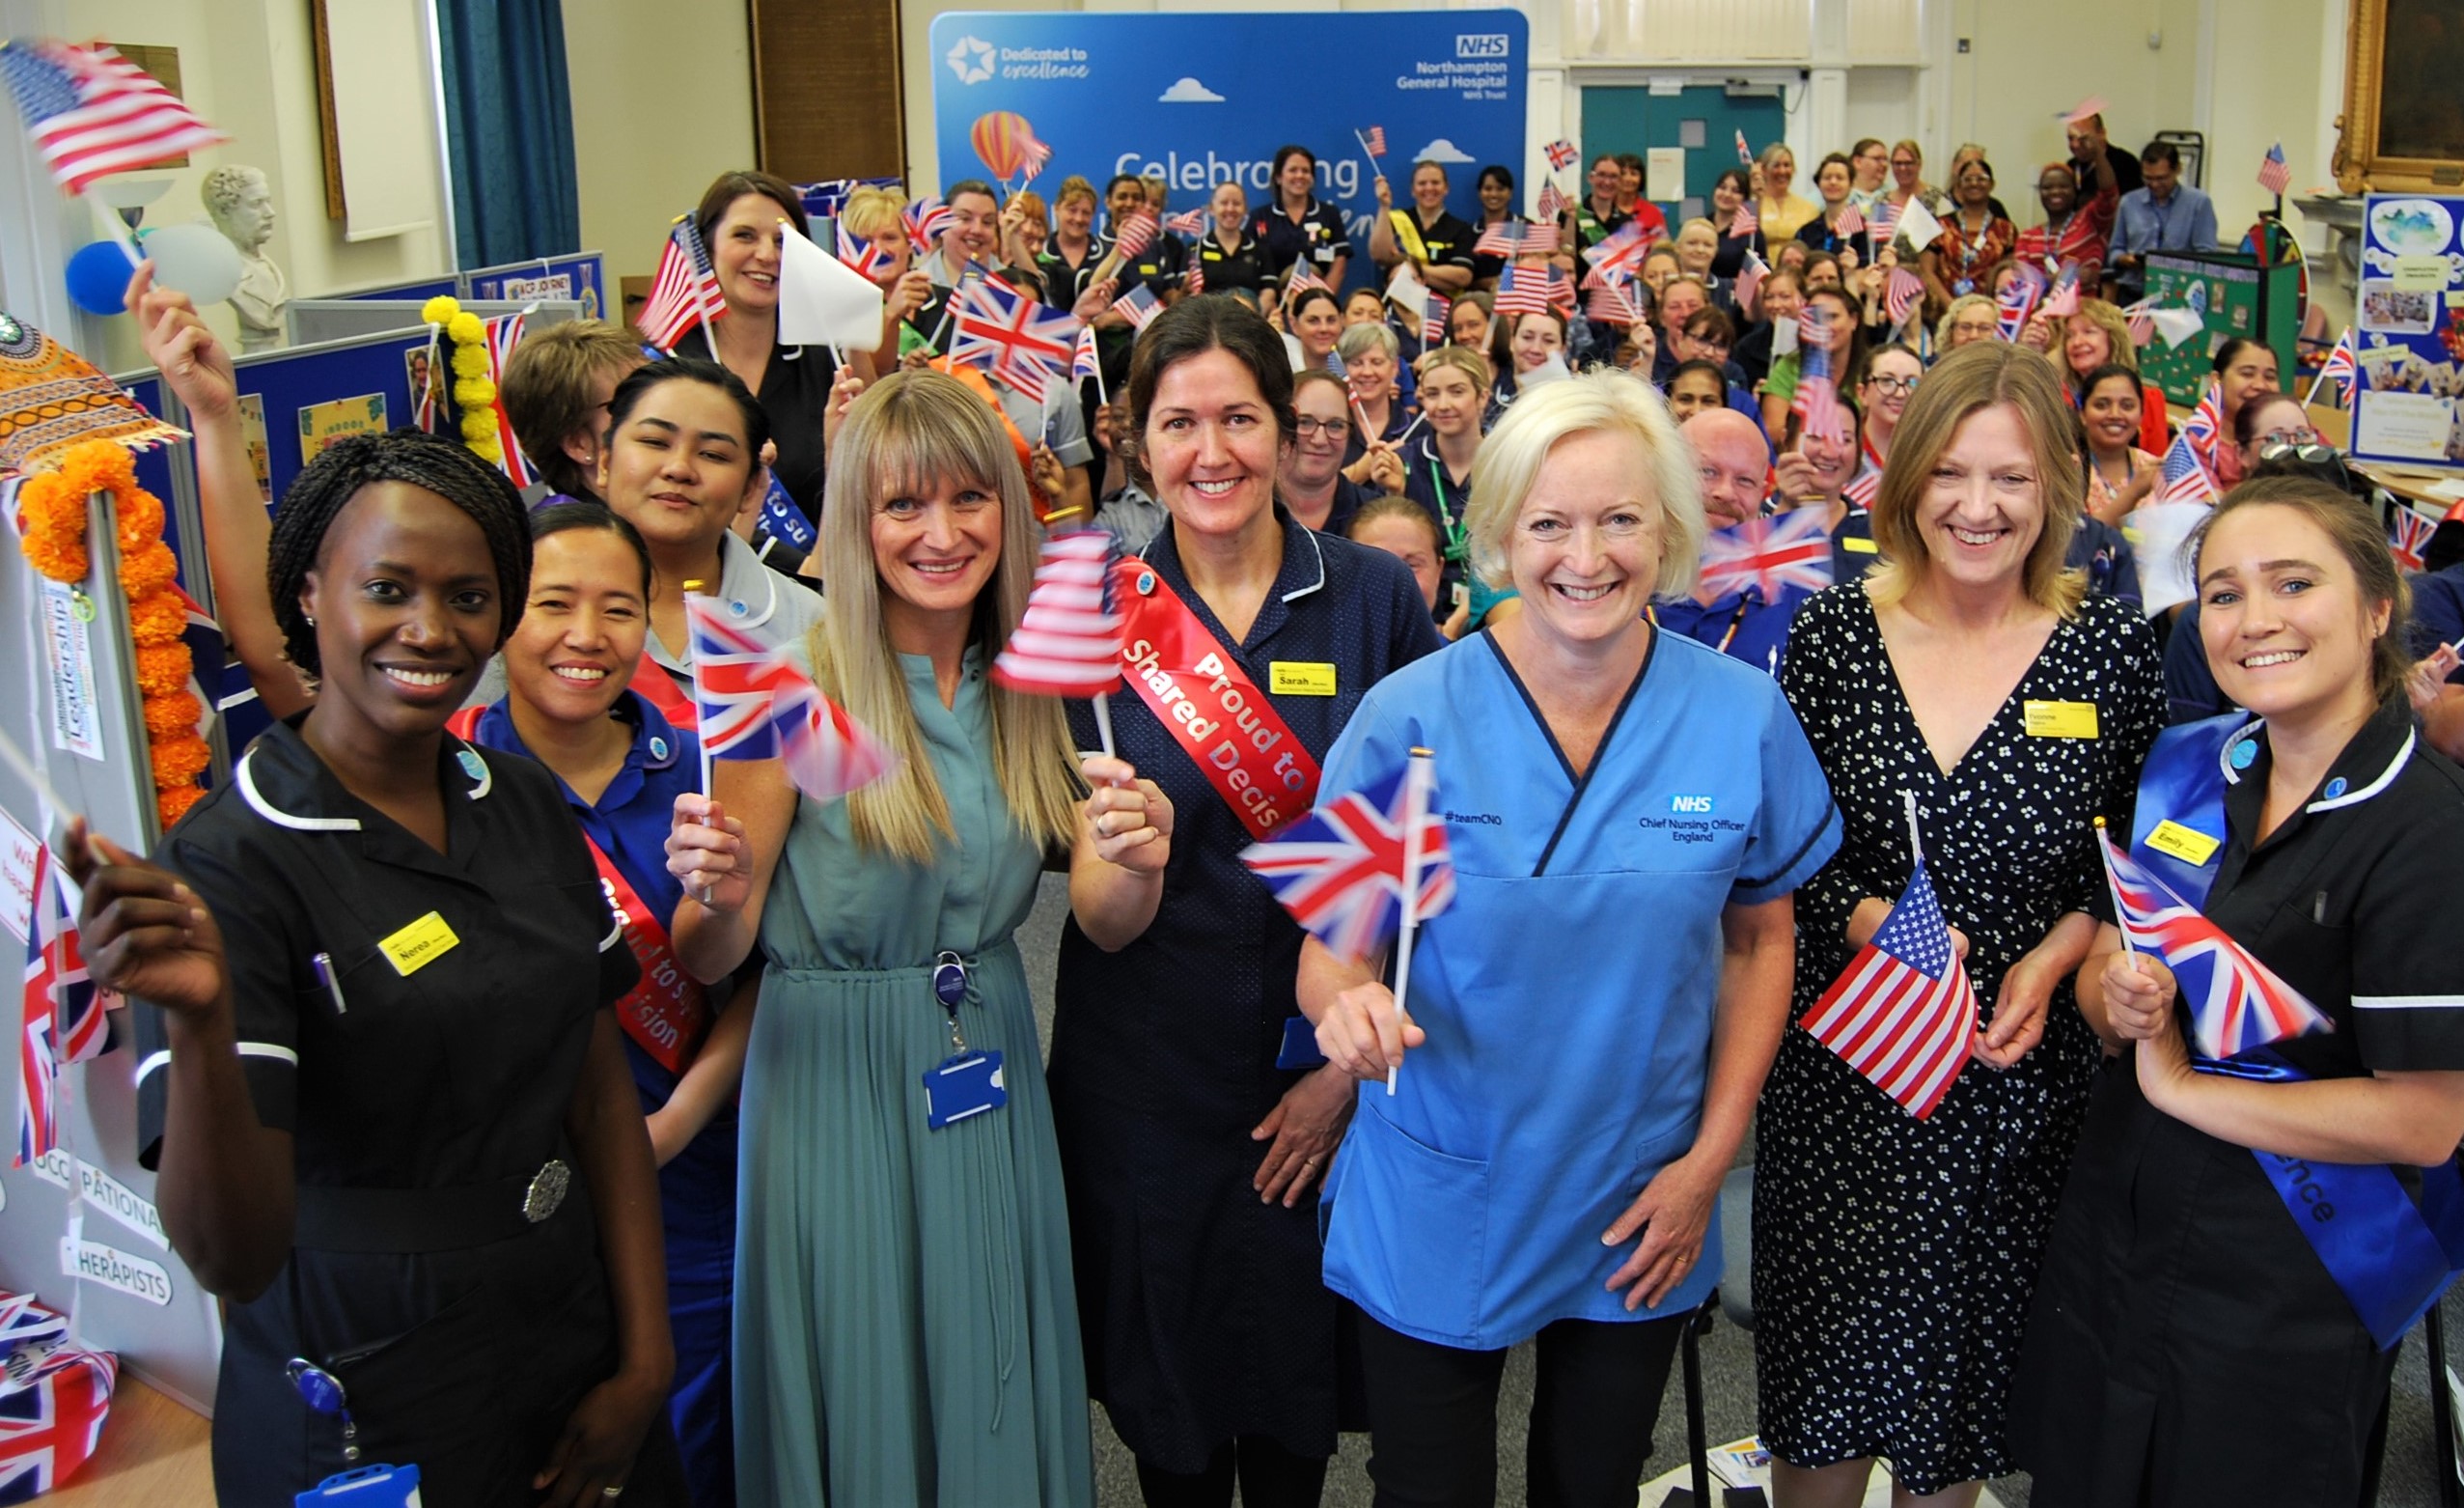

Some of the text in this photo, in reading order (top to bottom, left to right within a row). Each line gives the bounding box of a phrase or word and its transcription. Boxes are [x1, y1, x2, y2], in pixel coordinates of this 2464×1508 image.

[1001, 47, 1088, 61] Dedicated to
[1458, 36, 1506, 55] NHS
[1002, 62, 1090, 79] excellence
[1416, 61, 1508, 75] Northampton
[1397, 74, 1507, 90] General Hospital
[1114, 151, 1358, 199] Celebrang
[767, 490, 788, 517] to
[55, 600, 82, 739] Leadership
[1279, 677, 1309, 685] Sarah
[1194, 652, 1282, 754] Proud
[1273, 751, 1305, 792] to
[1122, 640, 1282, 829] Shared Decis
[1672, 796, 1712, 812] NHS
[1445, 811, 1502, 825] #teamCNO
[1640, 818, 1745, 831] Chief Nursing Officer
[1673, 832, 1713, 844] England
[2158, 833, 2184, 849] Emily
[399, 940, 430, 962] Nerea
[651, 959, 678, 987] to
[78, 1252, 166, 1299] HERAPISTS
